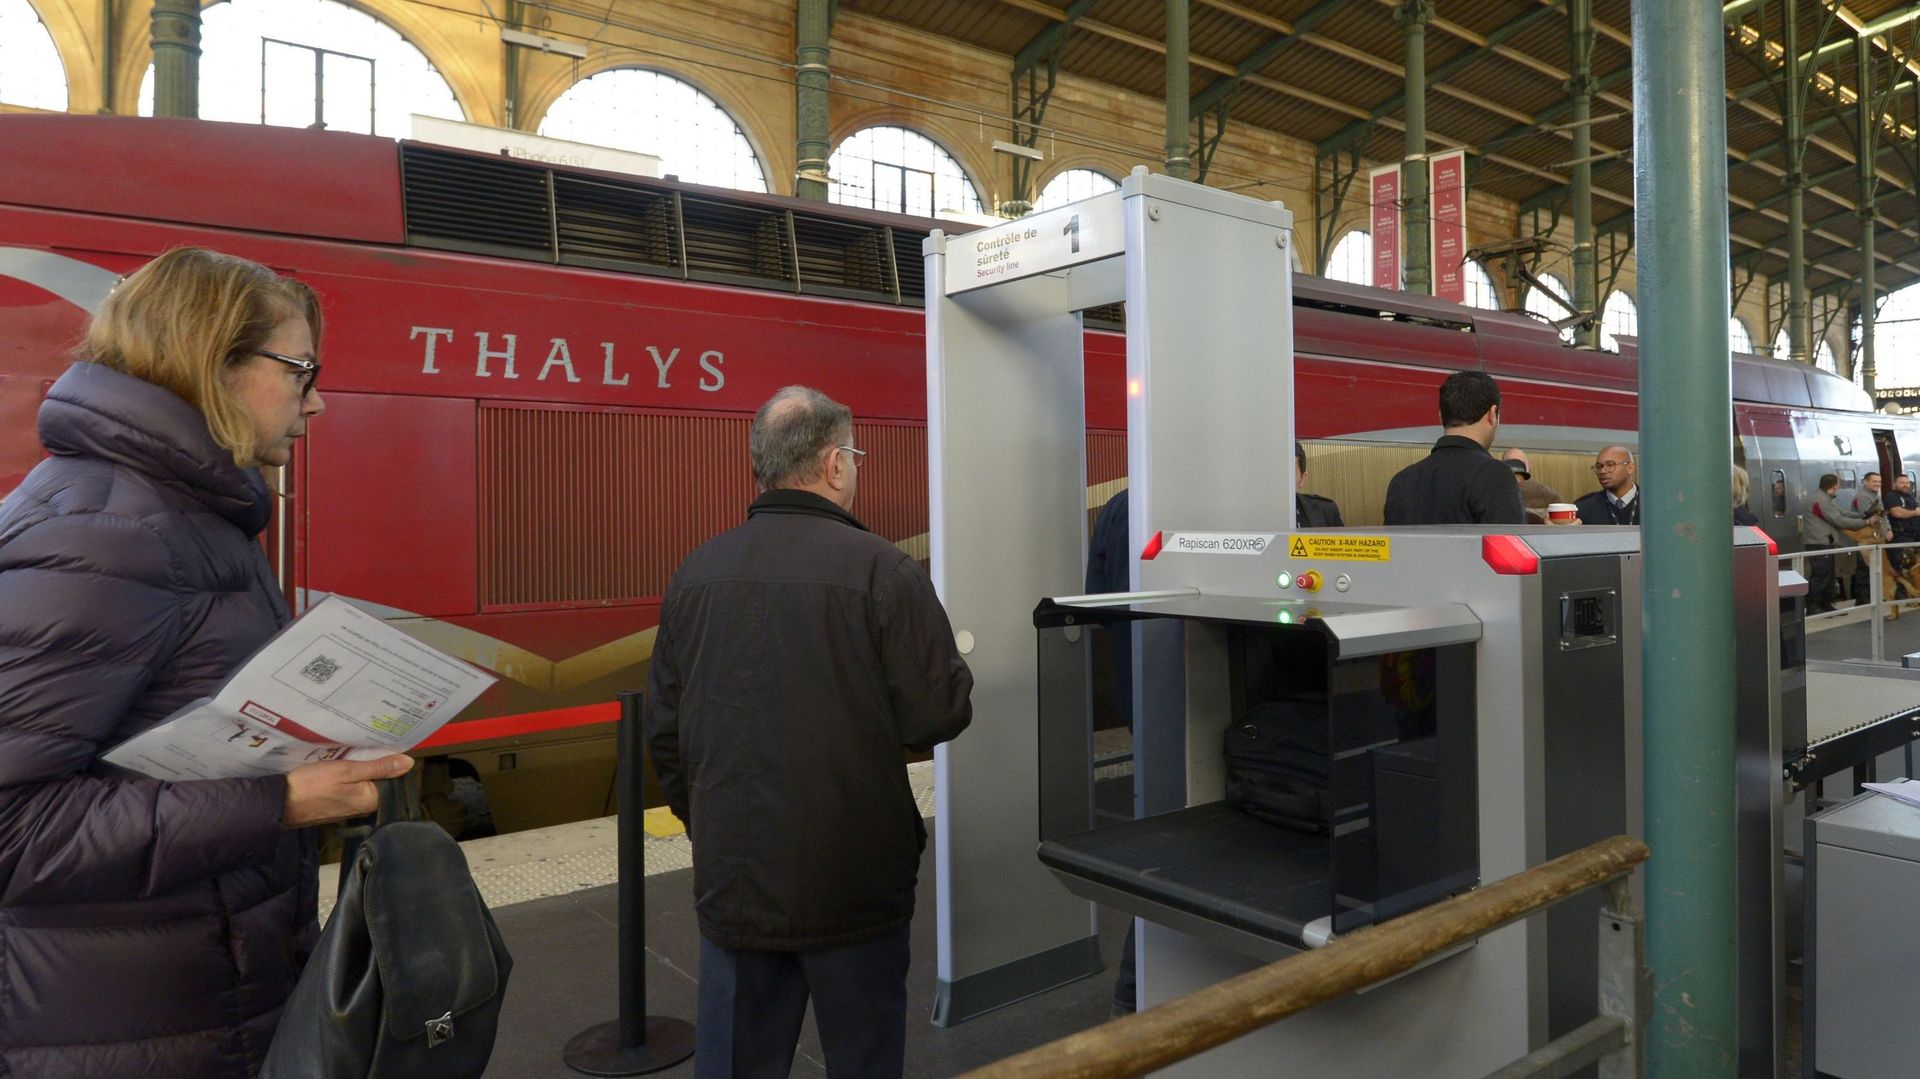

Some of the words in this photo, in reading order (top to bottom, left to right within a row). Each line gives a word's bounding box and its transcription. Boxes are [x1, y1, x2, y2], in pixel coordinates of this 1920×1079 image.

[513, 147, 556, 163] iPhone
[976, 233, 1021, 252] Contrôle
[1024, 228, 1037, 239] de
[1063, 214, 1080, 254] 1
[976, 248, 1010, 267] sûreté
[976, 265, 1005, 278] Security
[1006, 260, 1019, 271] line
[410, 326, 725, 391] THALYS
[1179, 537, 1220, 550] Rapiscan
[1309, 538, 1335, 546] CAUTION
[1338, 539, 1357, 547] X-RAY
